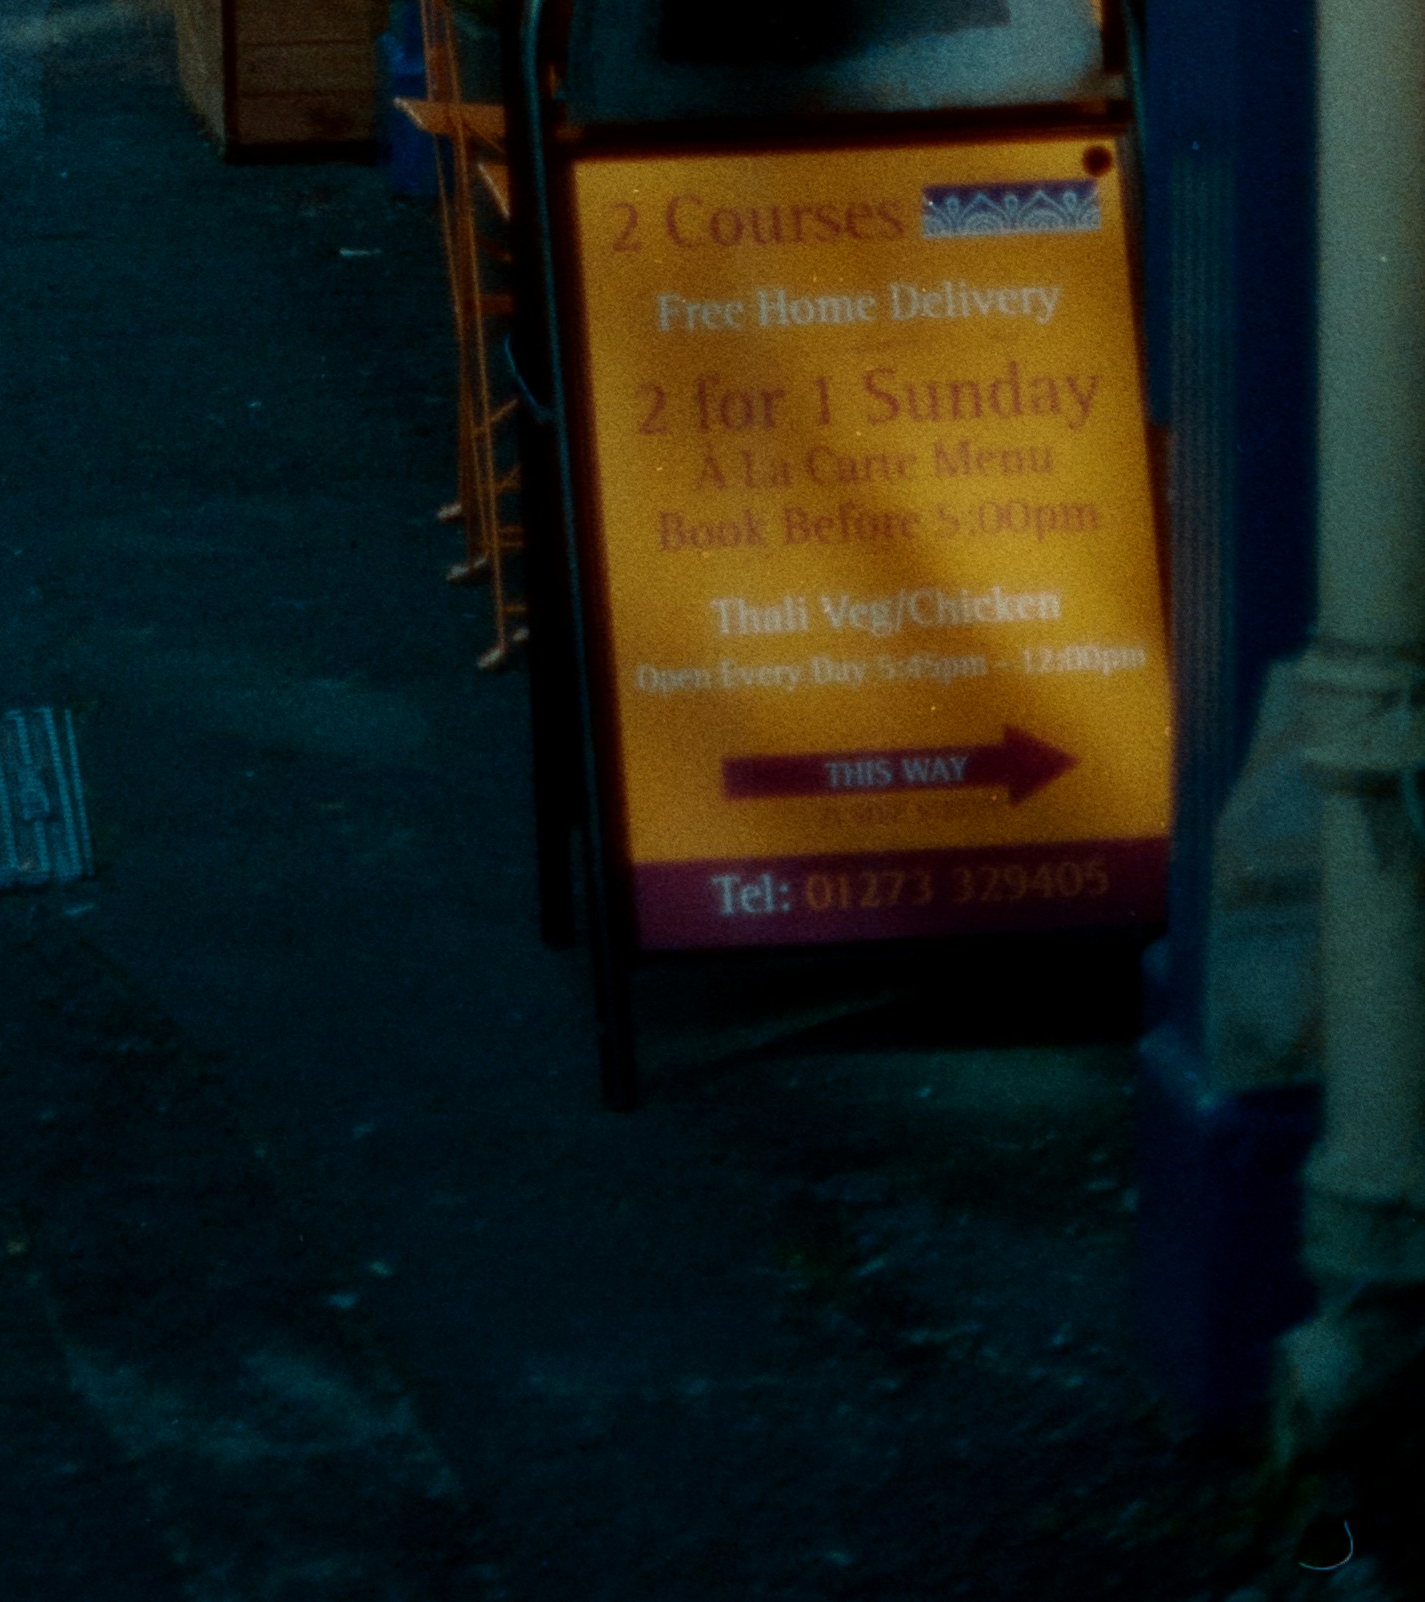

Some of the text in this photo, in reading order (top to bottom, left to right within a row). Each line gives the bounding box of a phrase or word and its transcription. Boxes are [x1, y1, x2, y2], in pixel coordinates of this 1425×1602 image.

[611, 188, 907, 254] 2 Courses
[656, 279, 1063, 332] Free Home Delivery
[635, 383, 670, 436] 2
[696, 373, 786, 432] for
[864, 361, 1101, 431] Sunday
[933, 439, 1055, 481] Menu
[656, 508, 766, 555] Book
[783, 502, 923, 547] Before
[711, 593, 808, 636] Thali
[825, 756, 969, 790] THIS WAY
[713, 874, 791, 915] Tel:
[805, 874, 935, 910] 01273
